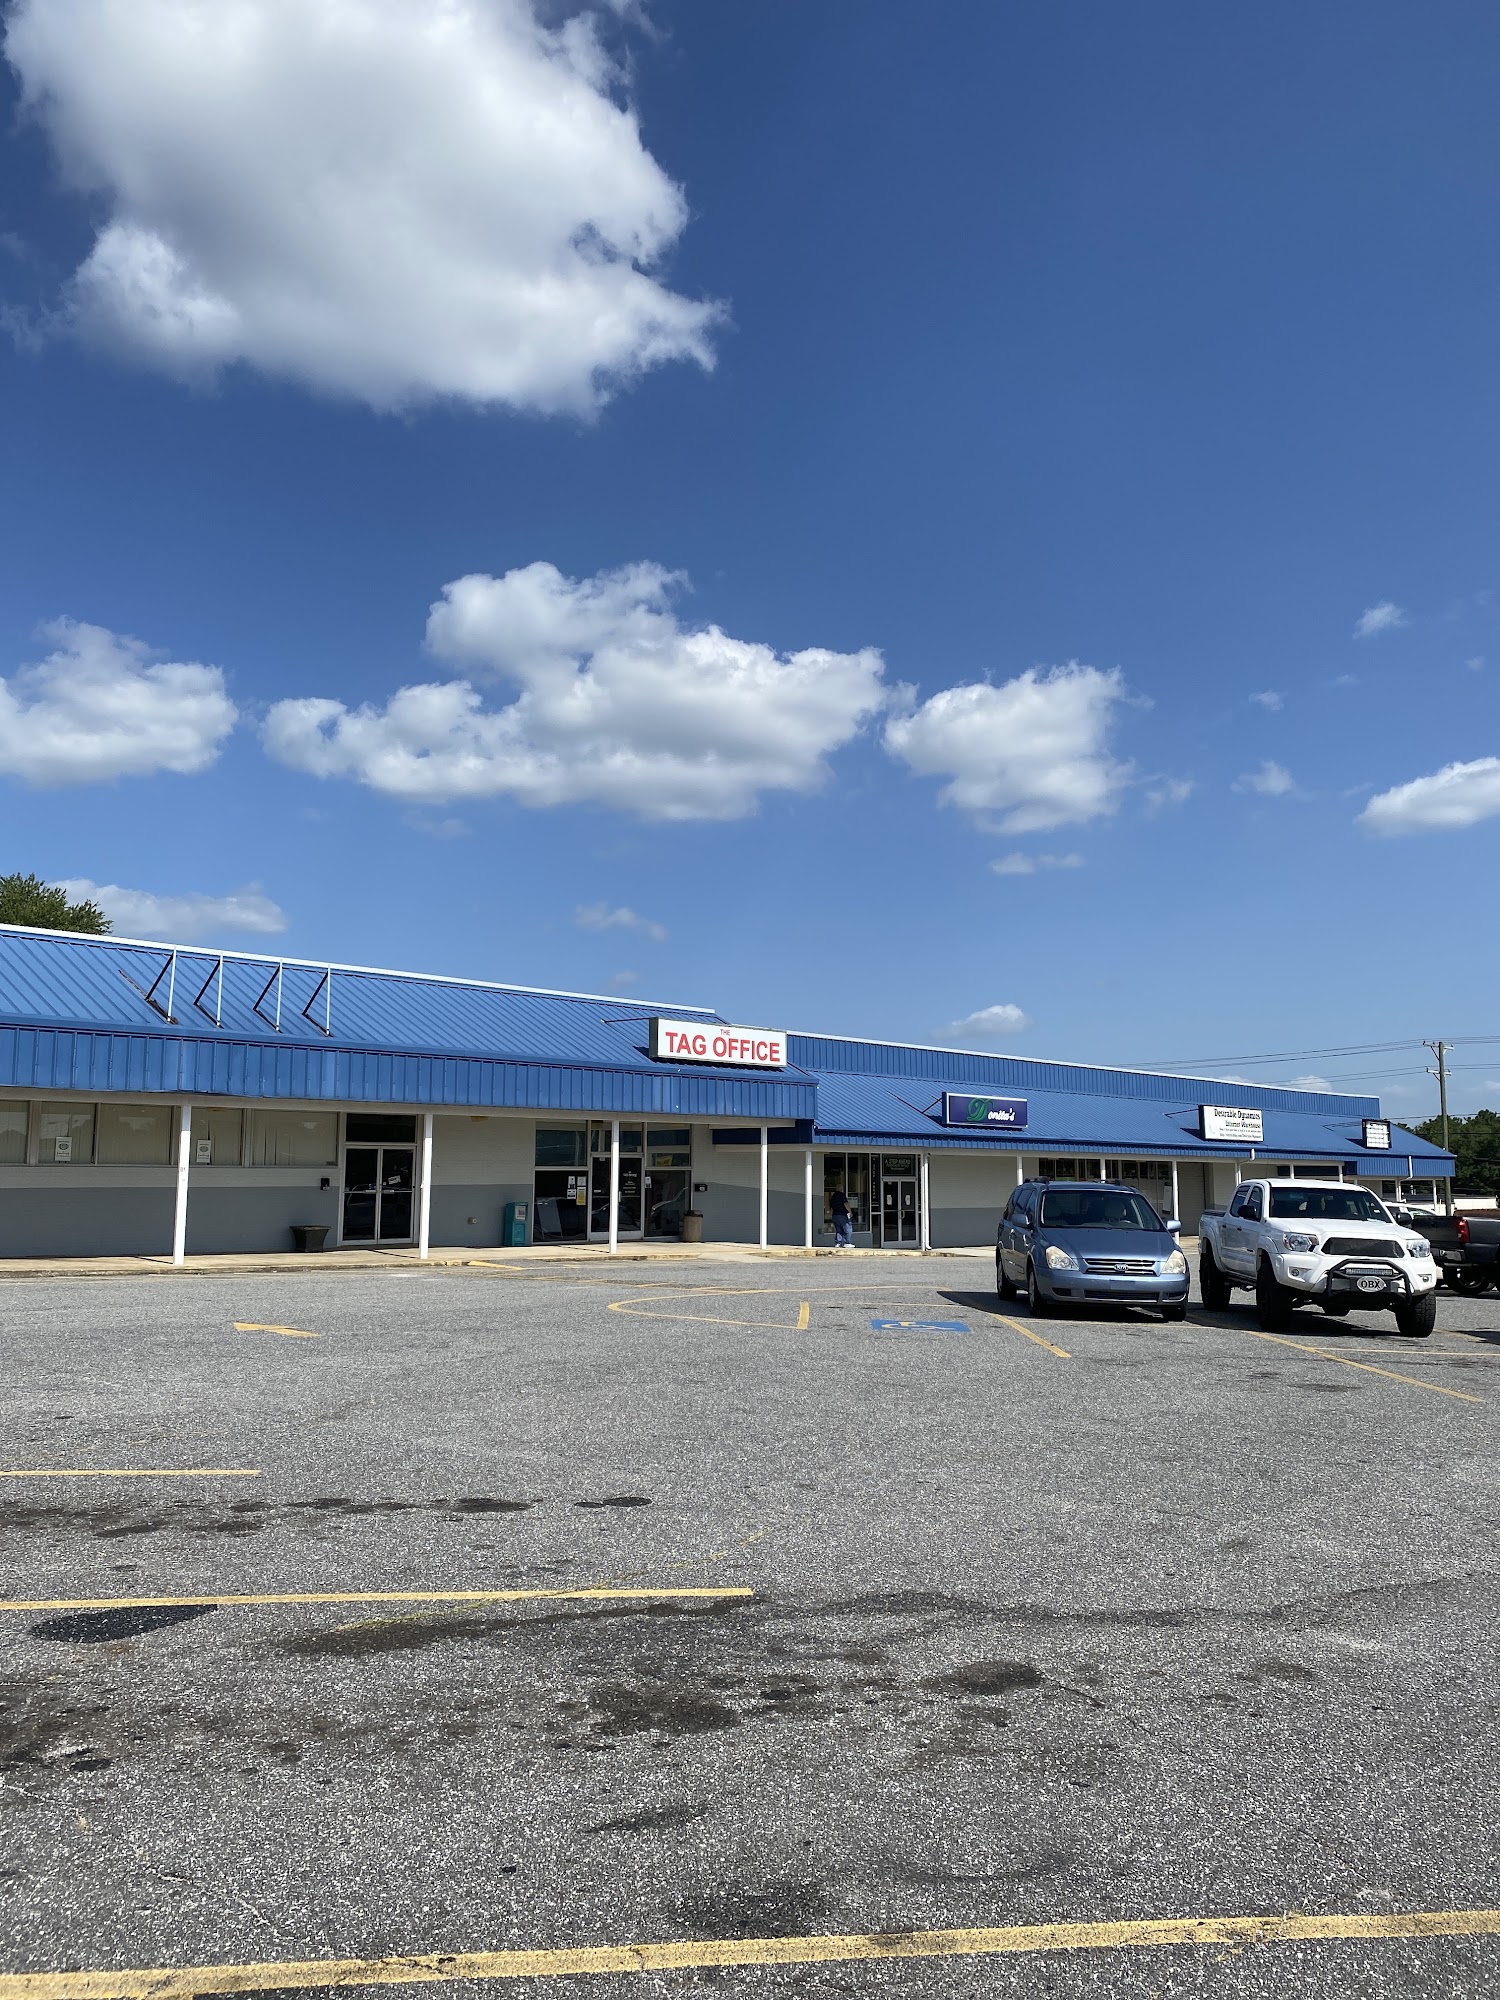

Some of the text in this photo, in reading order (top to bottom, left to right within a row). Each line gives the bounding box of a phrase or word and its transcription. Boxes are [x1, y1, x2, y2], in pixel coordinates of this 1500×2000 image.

[665, 1032, 780, 1062] TAG OFFICE
[966, 1097, 1016, 1122] Donita's
[1214, 1108, 1261, 1121] Desirable Dynamics
[1361, 1280, 1381, 1289] OBX
